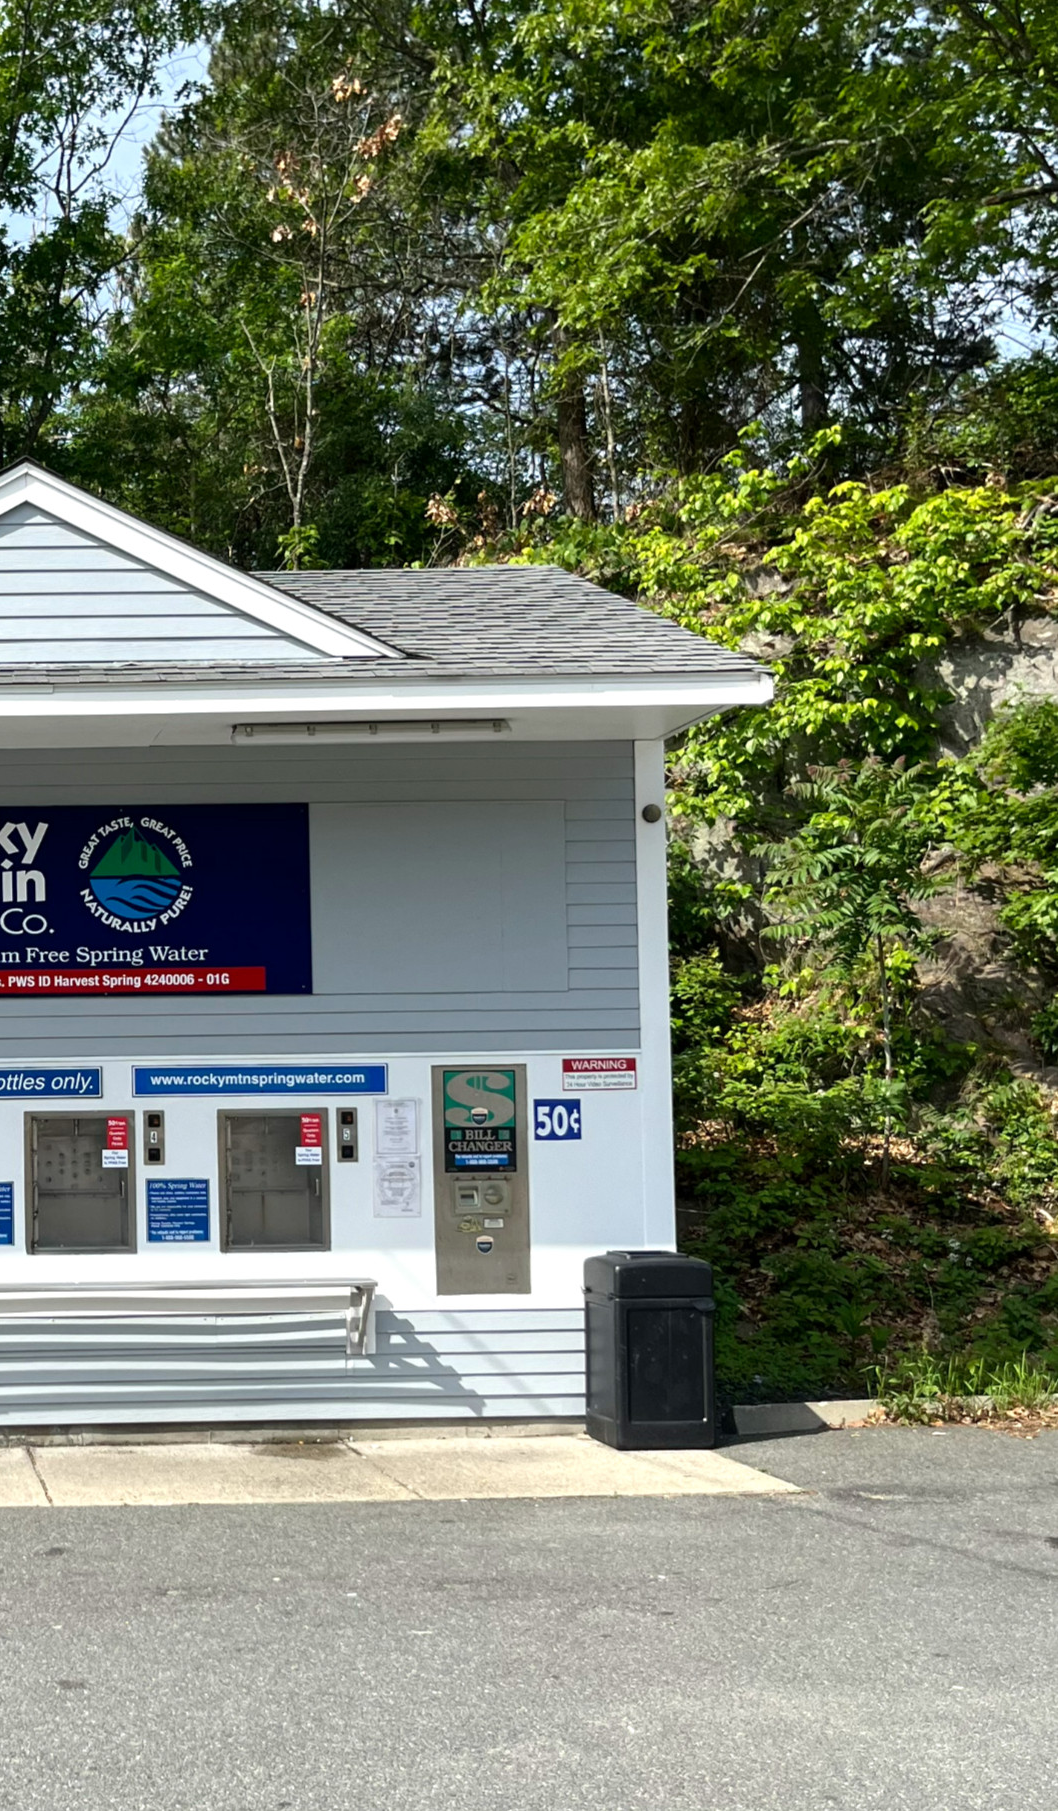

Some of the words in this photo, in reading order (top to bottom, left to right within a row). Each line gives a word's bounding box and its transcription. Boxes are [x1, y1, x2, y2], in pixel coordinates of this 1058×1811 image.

[78, 834, 101, 869] GREAT
[97, 817, 134, 837] TASTE,
[140, 817, 177, 839] GREAT
[172, 837, 193, 868] PRICE
[80, 888, 157, 933] NATURALLY
[159, 885, 193, 925] PURE!
[0, 908, 54, 934] Co.
[25, 947, 70, 963] Free
[76, 946, 144, 966] Spring
[149, 946, 208, 962] Water
[8, 975, 35, 988] PWS
[38, 975, 51, 987] ID
[54, 974, 99, 987] Harvest
[102, 974, 141, 988] Spring
[144, 974, 194, 986] 4240006
[571, 1060, 627, 1070] WARNING
[50, 1072, 94, 1093] only.
[150, 1072, 365, 1087] www.rockymtnspringwater.com
[536, 1105, 579, 1136] 50¢
[151, 1132, 156, 1142] 4
[344, 1129, 349, 1139] 5
[465, 1129, 495, 1140] BILL
[448, 1141, 513, 1152] CHANGER
[168, 1182, 188, 1190] Spring
